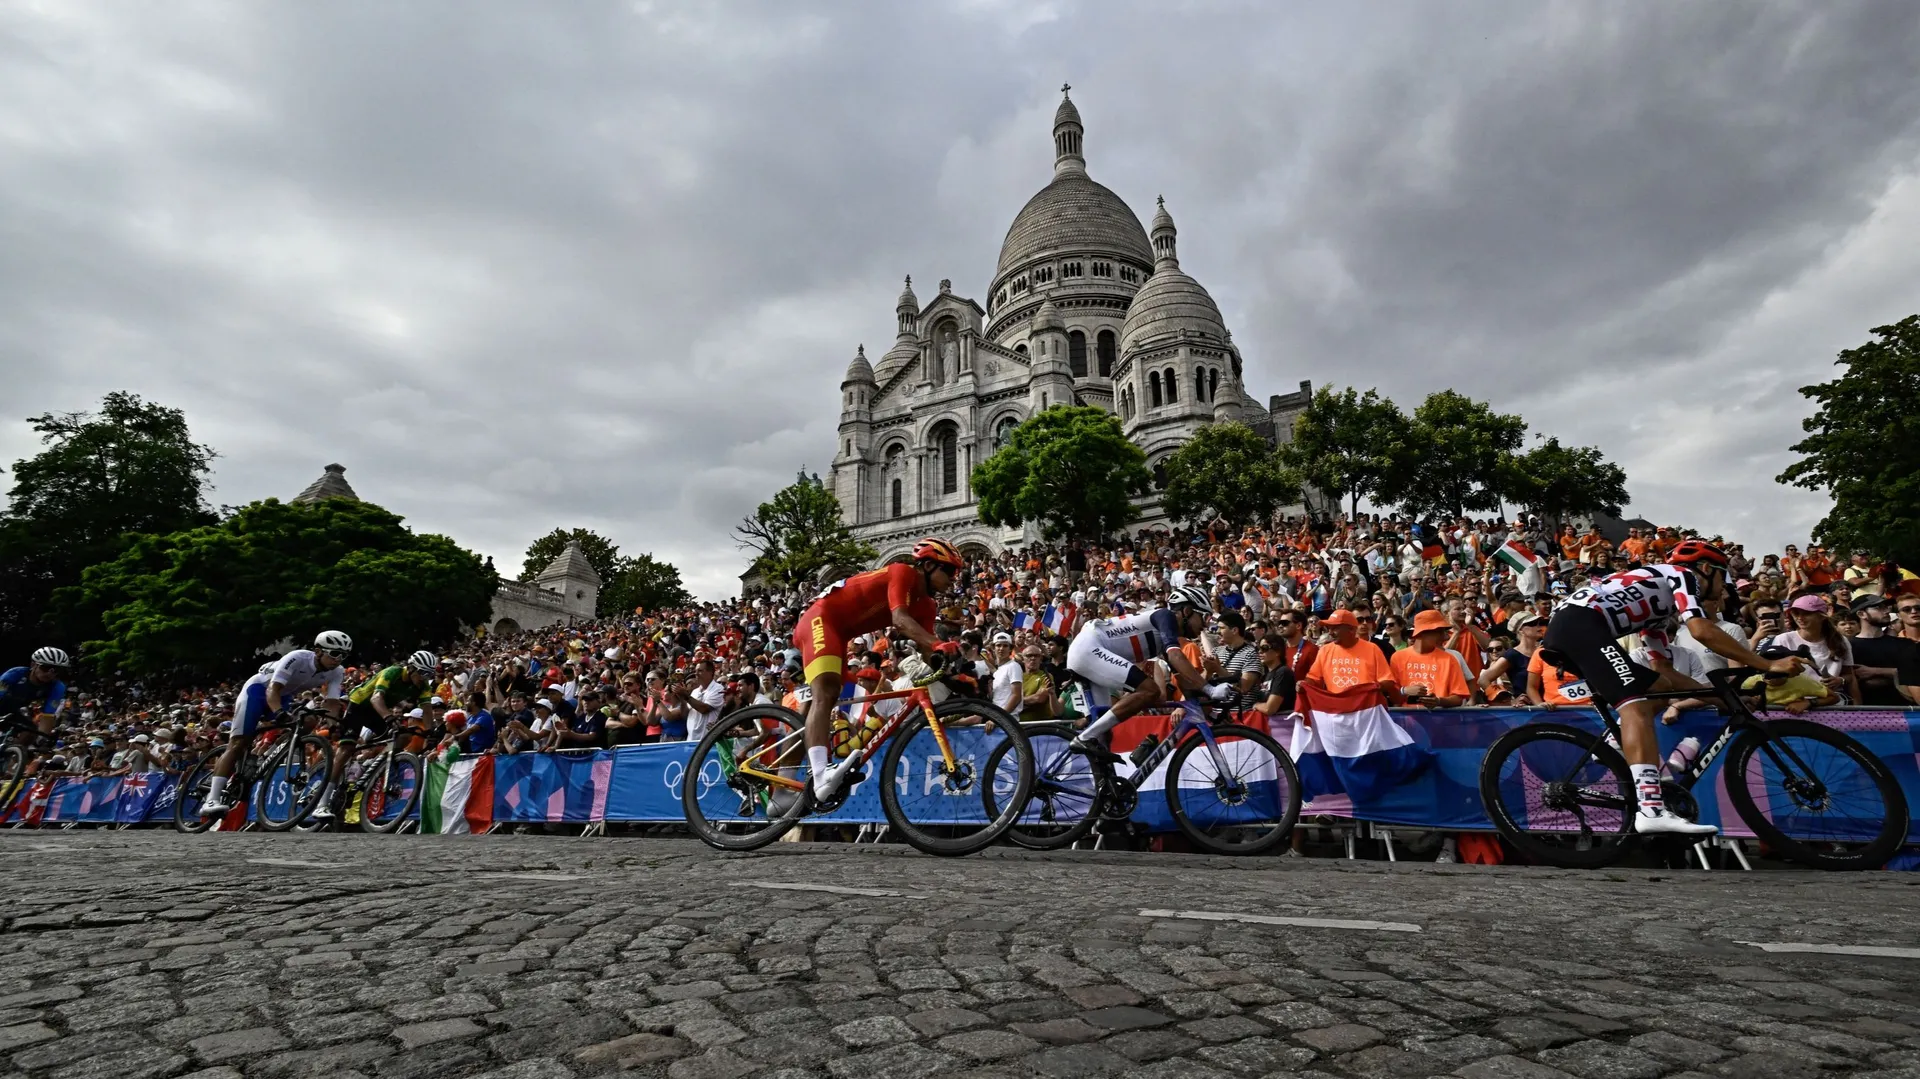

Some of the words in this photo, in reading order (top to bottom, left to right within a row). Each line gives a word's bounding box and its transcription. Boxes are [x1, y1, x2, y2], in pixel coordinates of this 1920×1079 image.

[1604, 586, 1644, 607] SRB
[811, 616, 826, 655] CHINA
[1332, 658, 1361, 666] PARIS
[1407, 662, 1437, 671] PARIS
[1600, 645, 1636, 686] SERBIA
[1332, 667, 1359, 675] 2024
[1408, 672, 1436, 680] 2024
[799, 688, 813, 700] 73
[1567, 686, 1586, 698] 86
[1074, 694, 1085, 706] 77
[1692, 725, 1734, 778] LOOK
[1129, 731, 1179, 788] GIANT
